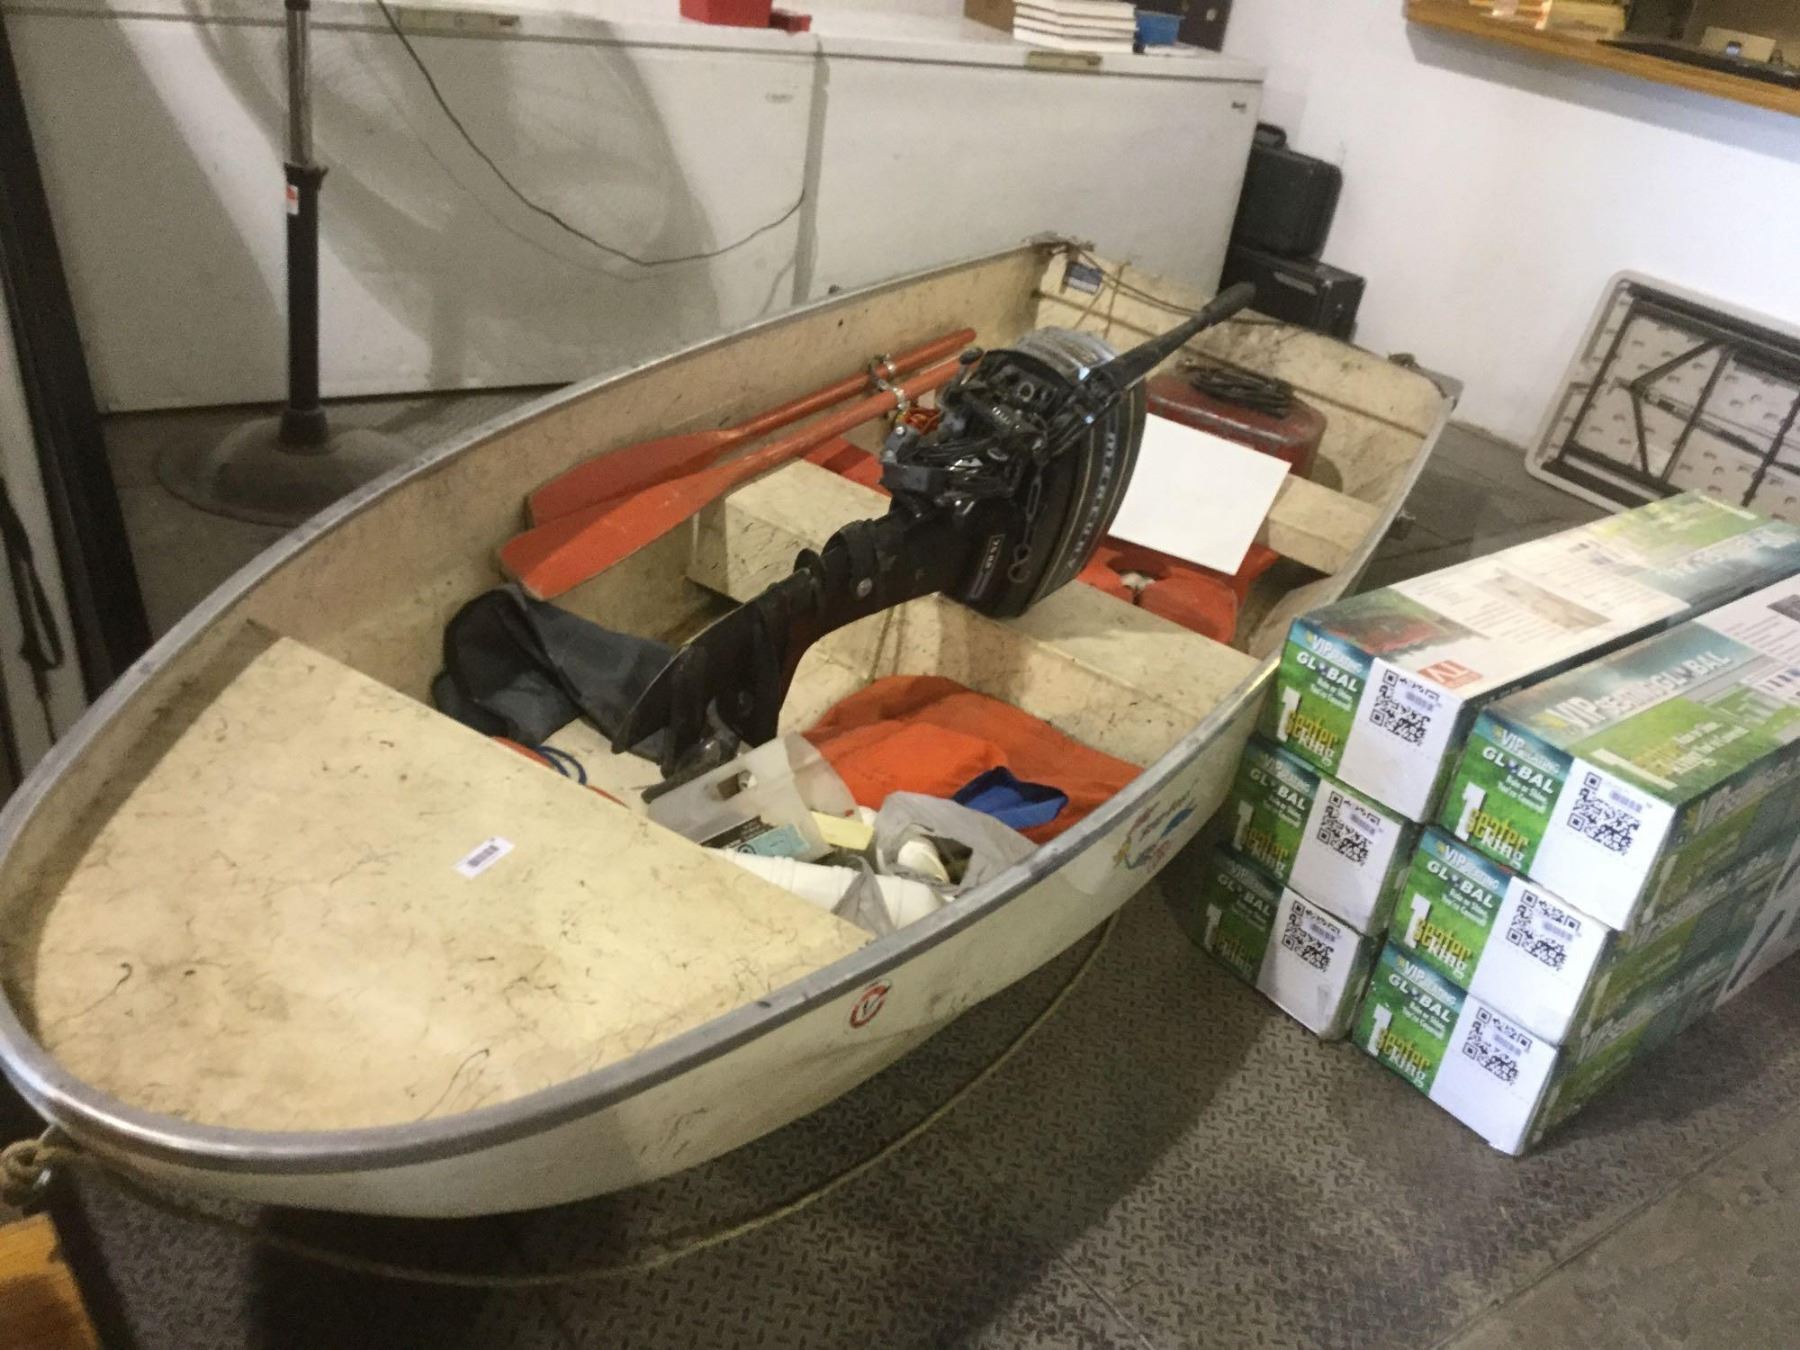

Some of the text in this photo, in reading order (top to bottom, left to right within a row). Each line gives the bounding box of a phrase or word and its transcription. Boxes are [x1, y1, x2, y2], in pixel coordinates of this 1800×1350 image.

[1277, 686, 1301, 742] 1
[1454, 781, 1487, 842] 1
[1404, 891, 1431, 949] 1
[1367, 1003, 1392, 1057] 1
